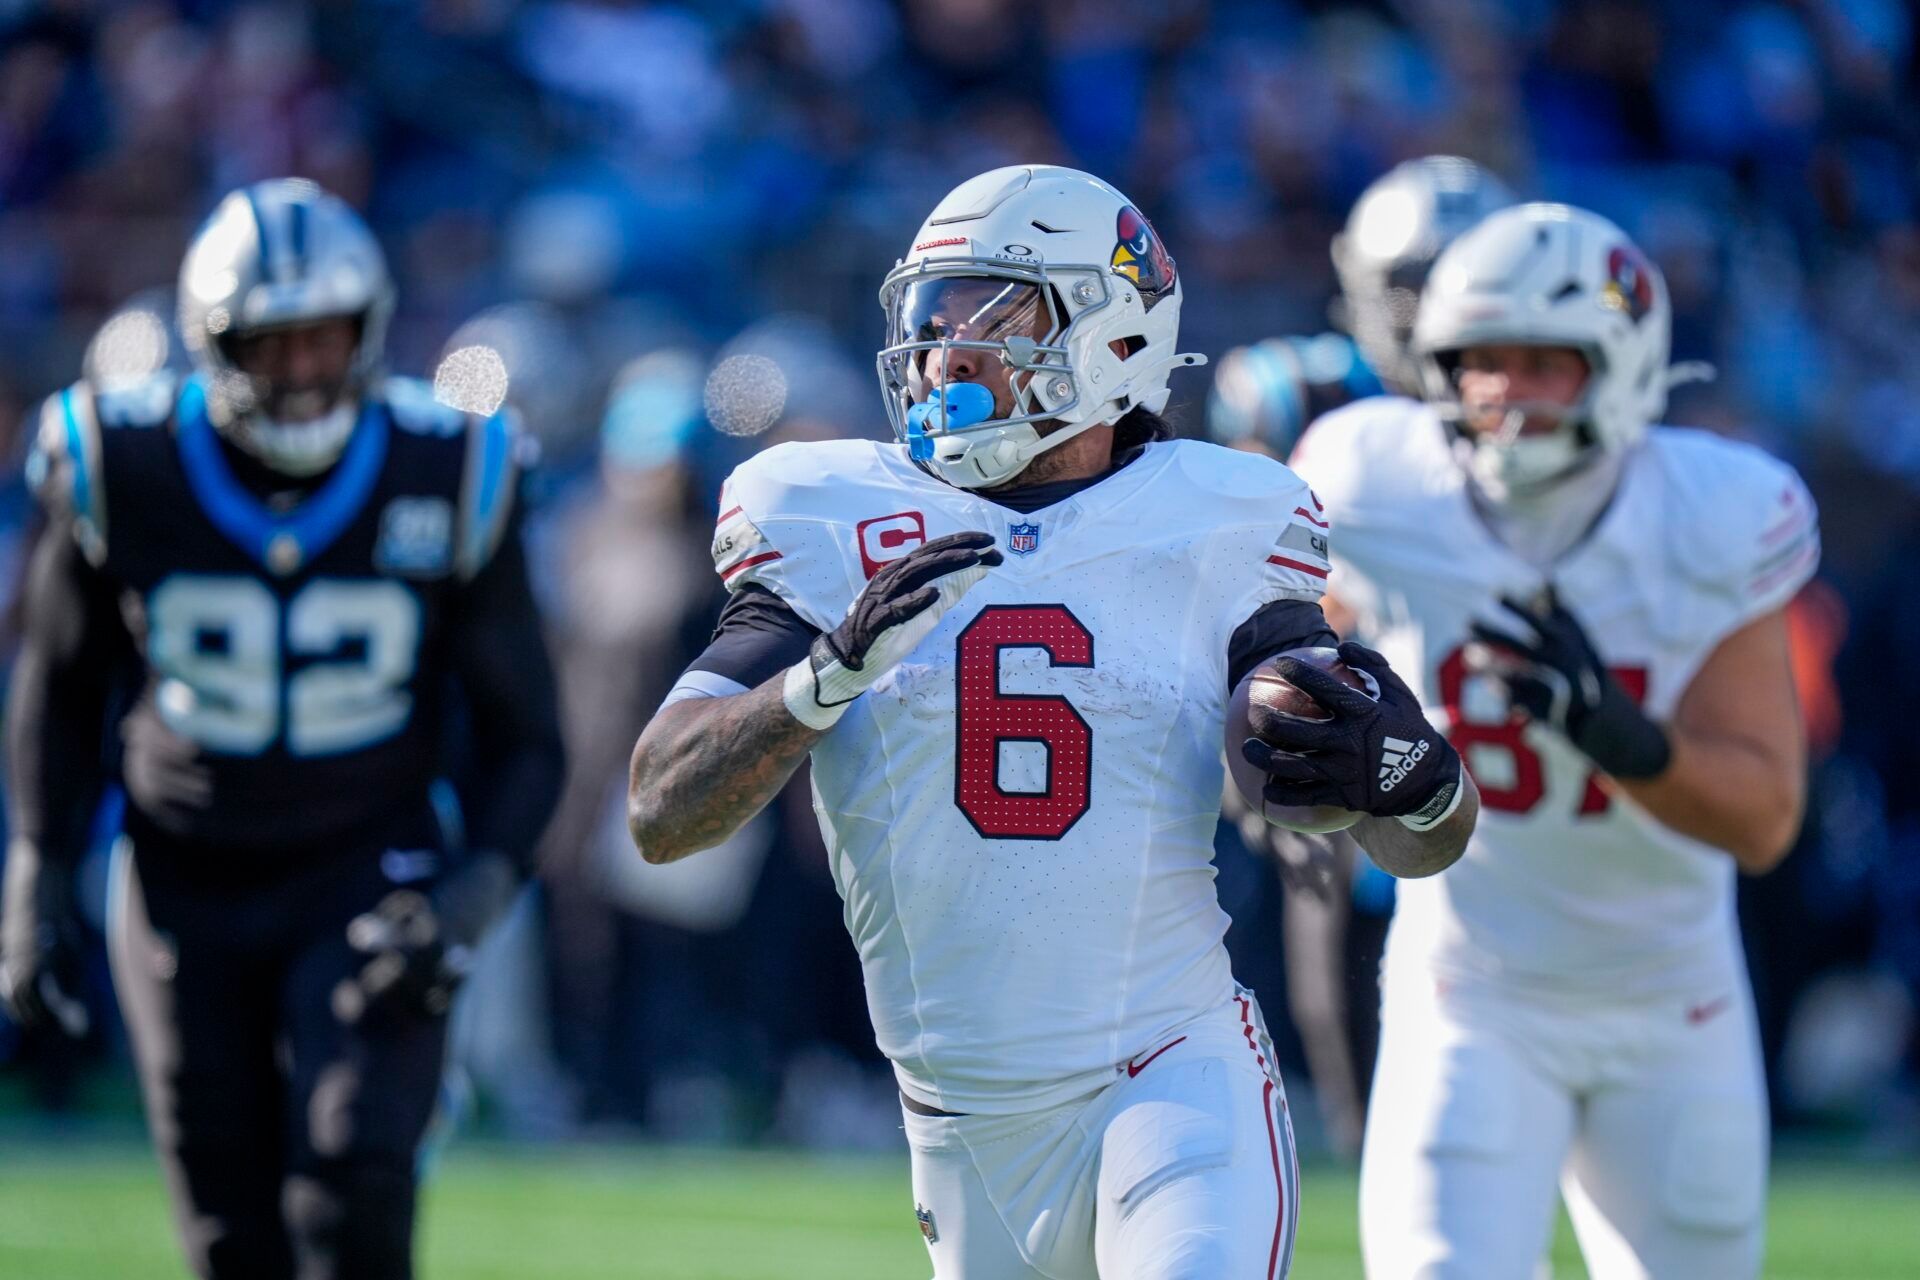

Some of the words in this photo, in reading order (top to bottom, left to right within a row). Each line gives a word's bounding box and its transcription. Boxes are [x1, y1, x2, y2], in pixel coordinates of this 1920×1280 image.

[1012, 535, 1036, 550] NFL
[147, 573, 422, 757] 92
[954, 603, 1095, 841] 6
[1380, 739, 1430, 792] adidas
